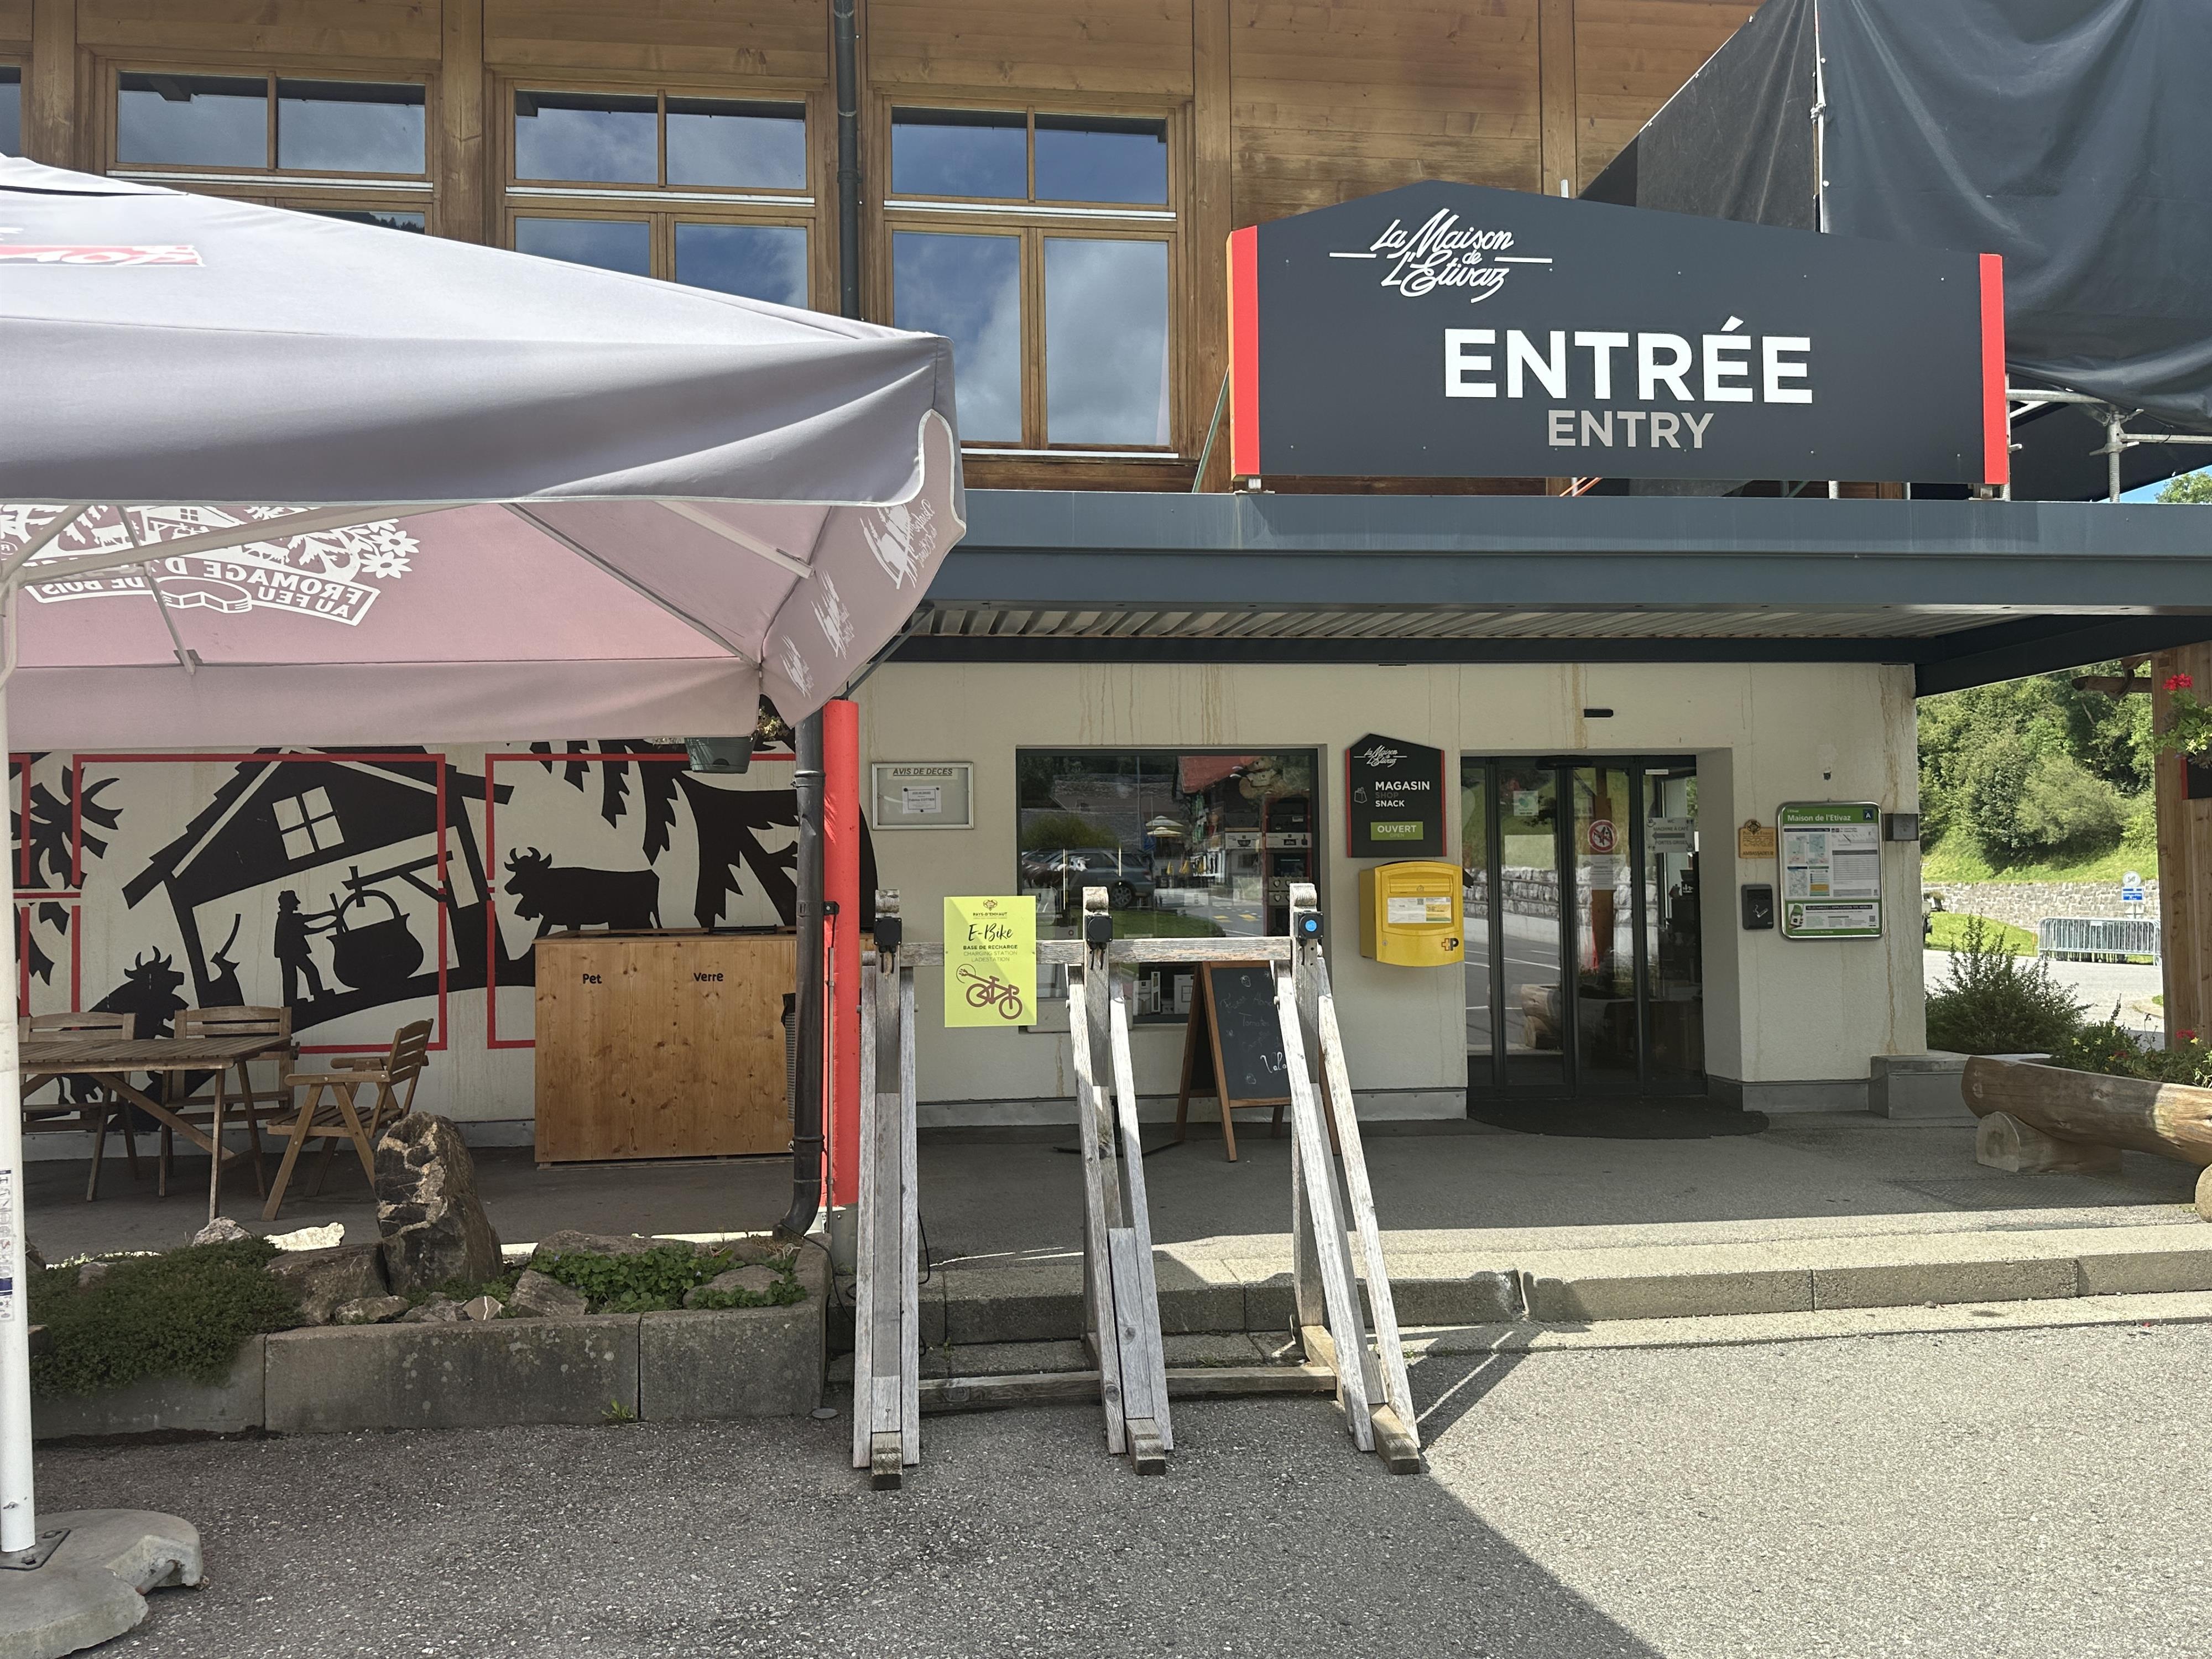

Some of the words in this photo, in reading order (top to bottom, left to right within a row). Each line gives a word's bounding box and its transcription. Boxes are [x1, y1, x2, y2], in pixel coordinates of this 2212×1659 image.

[1370, 220, 1408, 252] La
[1387, 208, 1515, 258] Maison
[1462, 249, 1483, 264] de
[1444, 315, 1813, 404] ENTRÉE
[1548, 410, 1714, 448] ENTRY
[1364, 748, 1373, 756] La
[1368, 745, 1398, 758] Maison
[1375, 781, 1430, 790] MAGASIN
[968, 923, 1013, 941] E-Bike
[582, 973, 602, 984] Pet
[693, 972, 723, 982] Verre
